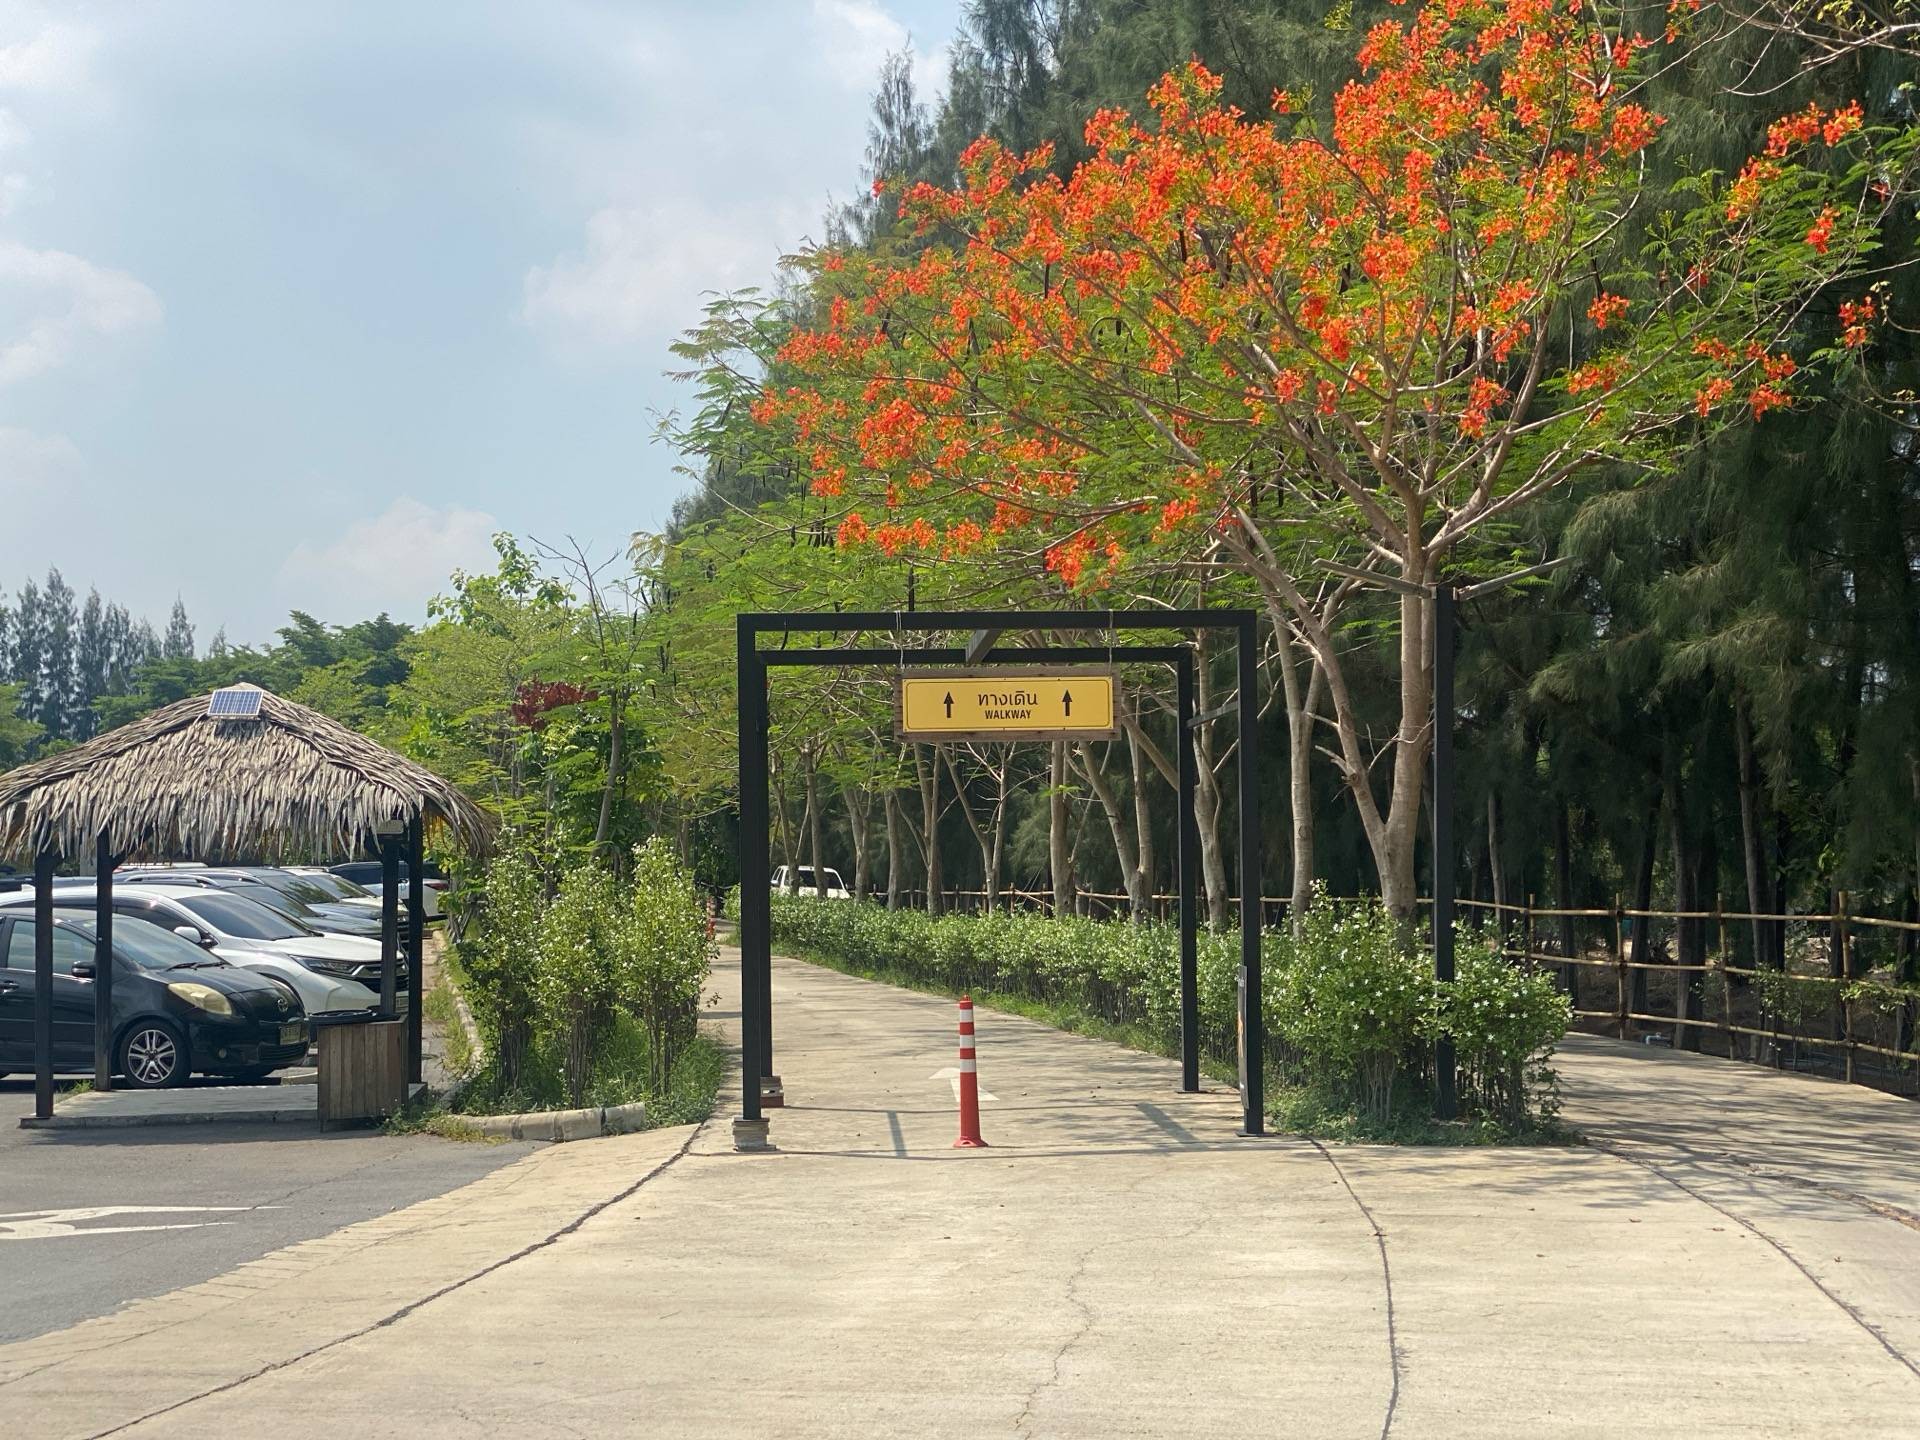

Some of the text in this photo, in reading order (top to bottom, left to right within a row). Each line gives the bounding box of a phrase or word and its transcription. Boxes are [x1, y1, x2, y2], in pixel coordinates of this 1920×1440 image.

[978, 690, 1038, 706] ทางเดิน
[985, 709, 1032, 720] WALKWAY
